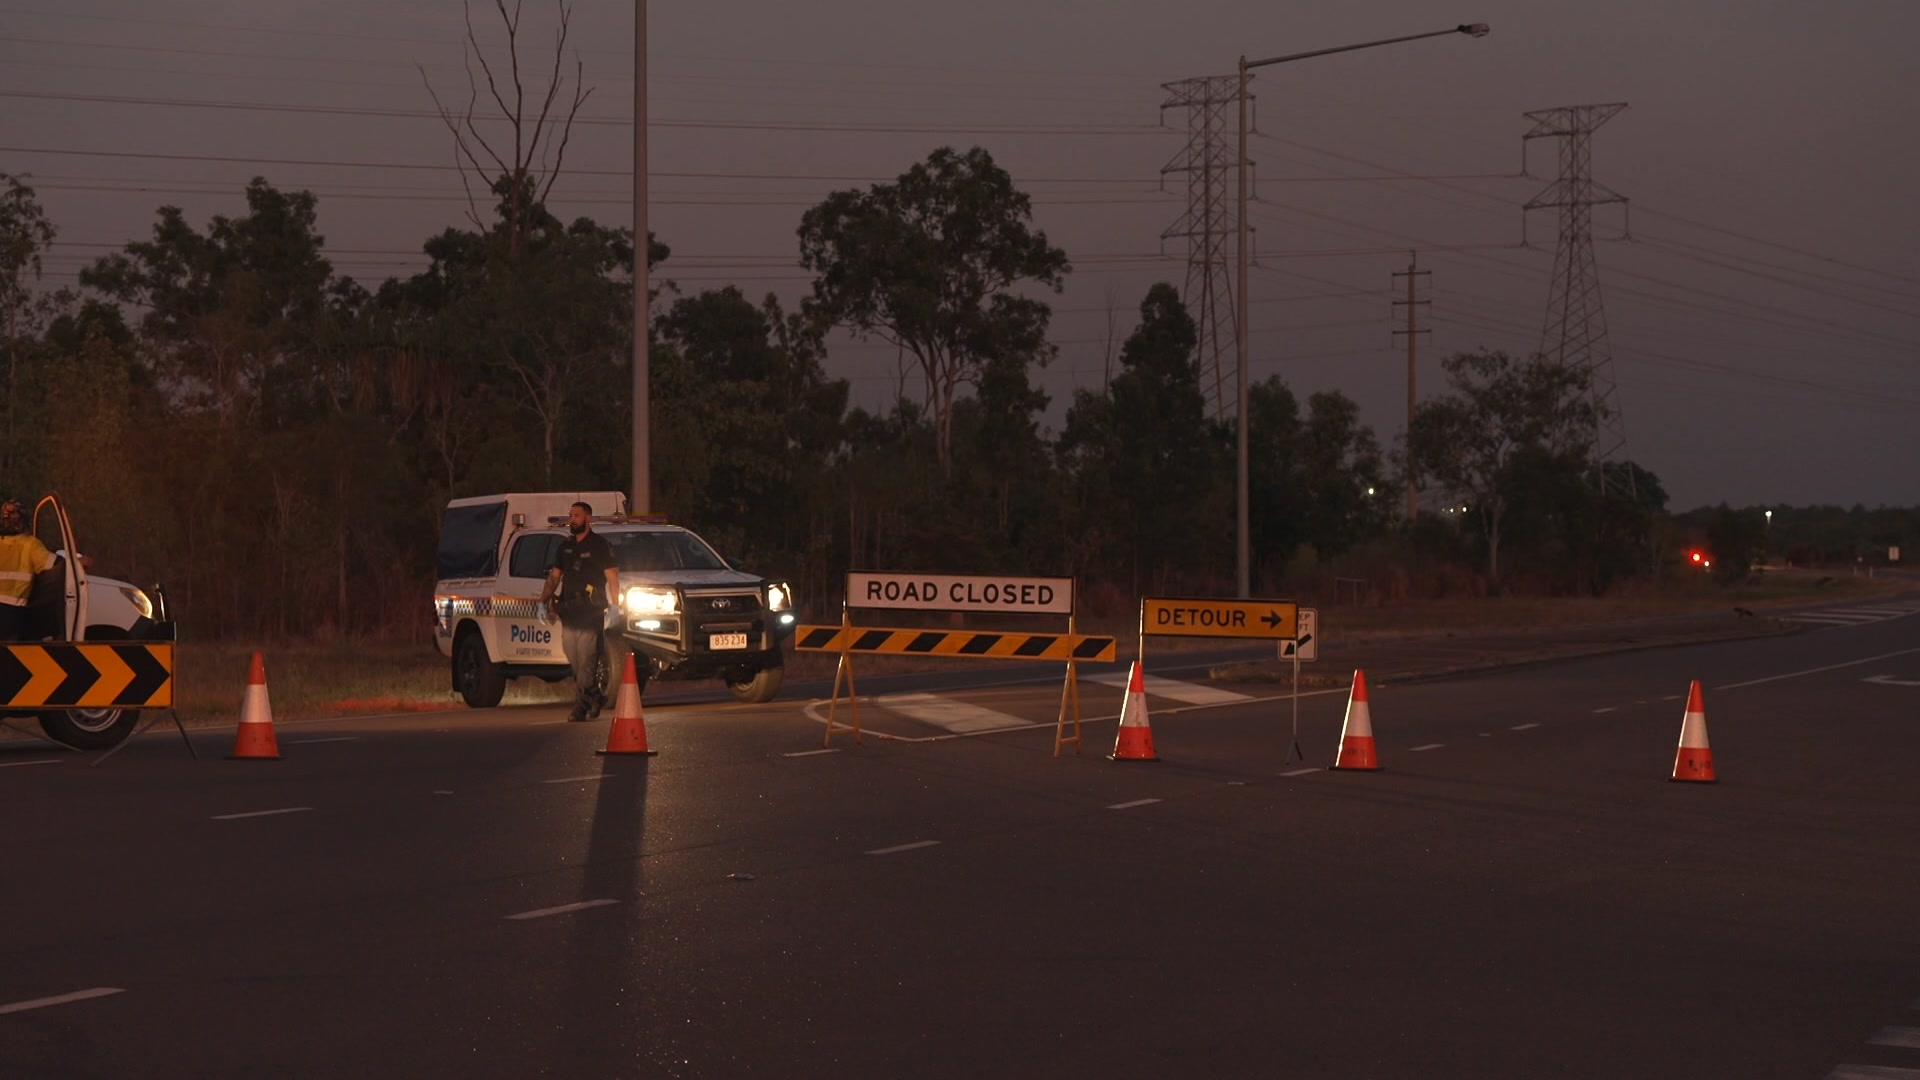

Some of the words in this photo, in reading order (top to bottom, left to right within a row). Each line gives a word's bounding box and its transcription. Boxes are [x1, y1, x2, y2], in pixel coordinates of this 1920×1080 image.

[867, 581, 938, 601] ROAD
[950, 583, 1054, 605] CLOSED
[1157, 608, 1246, 627] DETOUR
[511, 625, 551, 643] Police
